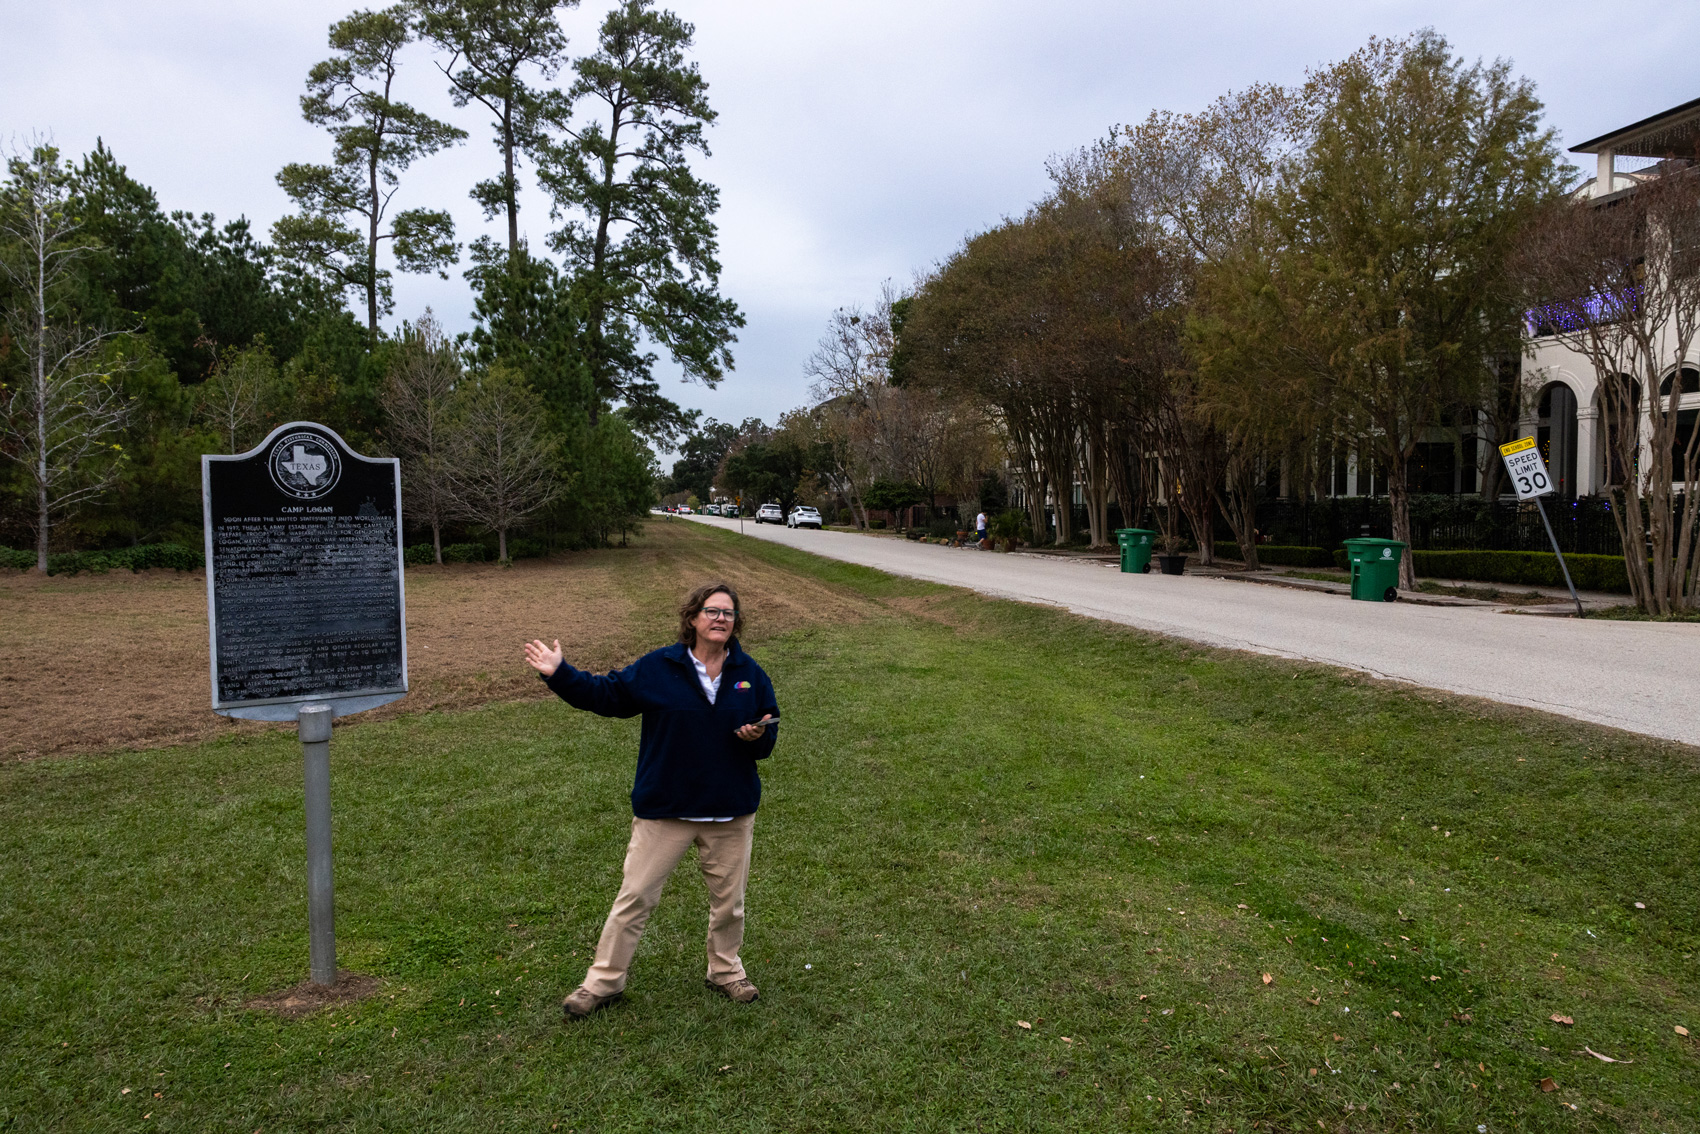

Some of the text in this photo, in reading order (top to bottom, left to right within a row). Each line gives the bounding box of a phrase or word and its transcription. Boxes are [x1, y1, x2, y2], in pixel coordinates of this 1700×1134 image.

[1508, 452, 1538, 467] SPEED
[1515, 462, 1537, 475] LIMIT
[1518, 472, 1547, 494] 30
